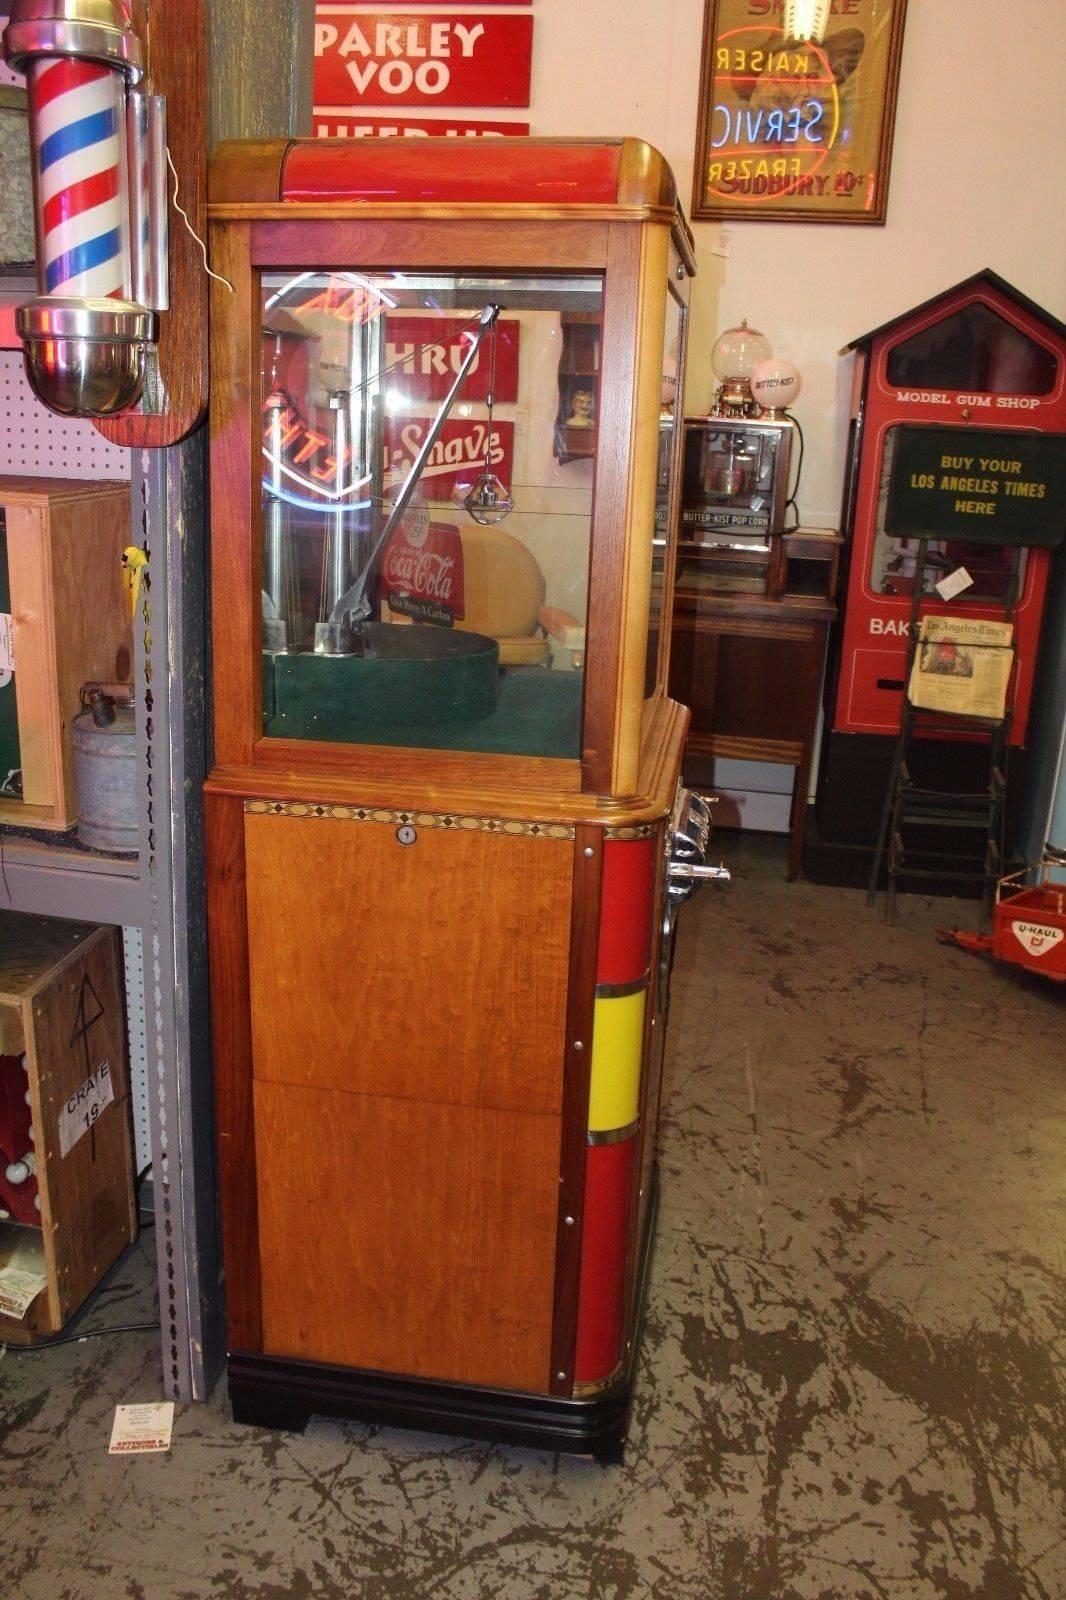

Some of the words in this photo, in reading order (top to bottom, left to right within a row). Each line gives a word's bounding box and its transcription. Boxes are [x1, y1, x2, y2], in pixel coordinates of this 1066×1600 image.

[314, 22, 485, 58] PARLEY
[346, 60, 450, 95] VOO
[896, 392, 951, 405] MODEL
[957, 395, 991, 407] GUM
[996, 397, 1041, 410] SHOP
[941, 455, 974, 470] BUY
[980, 459, 1022, 474] YOUR
[911, 474, 935, 489] LOS
[940, 477, 999, 495] ANGELES
[1005, 481, 1046, 498] TIMES
[955, 500, 997, 515] HERE
[683, 512, 730, 524] BUTTER-KIST
[732, 515, 747, 526] POP
[927, 621, 939, 631] Los
[941, 621, 977, 635] Angeles
[979, 624, 1006, 637] Times
[1019, 925, 1058, 938] U-HAUL
